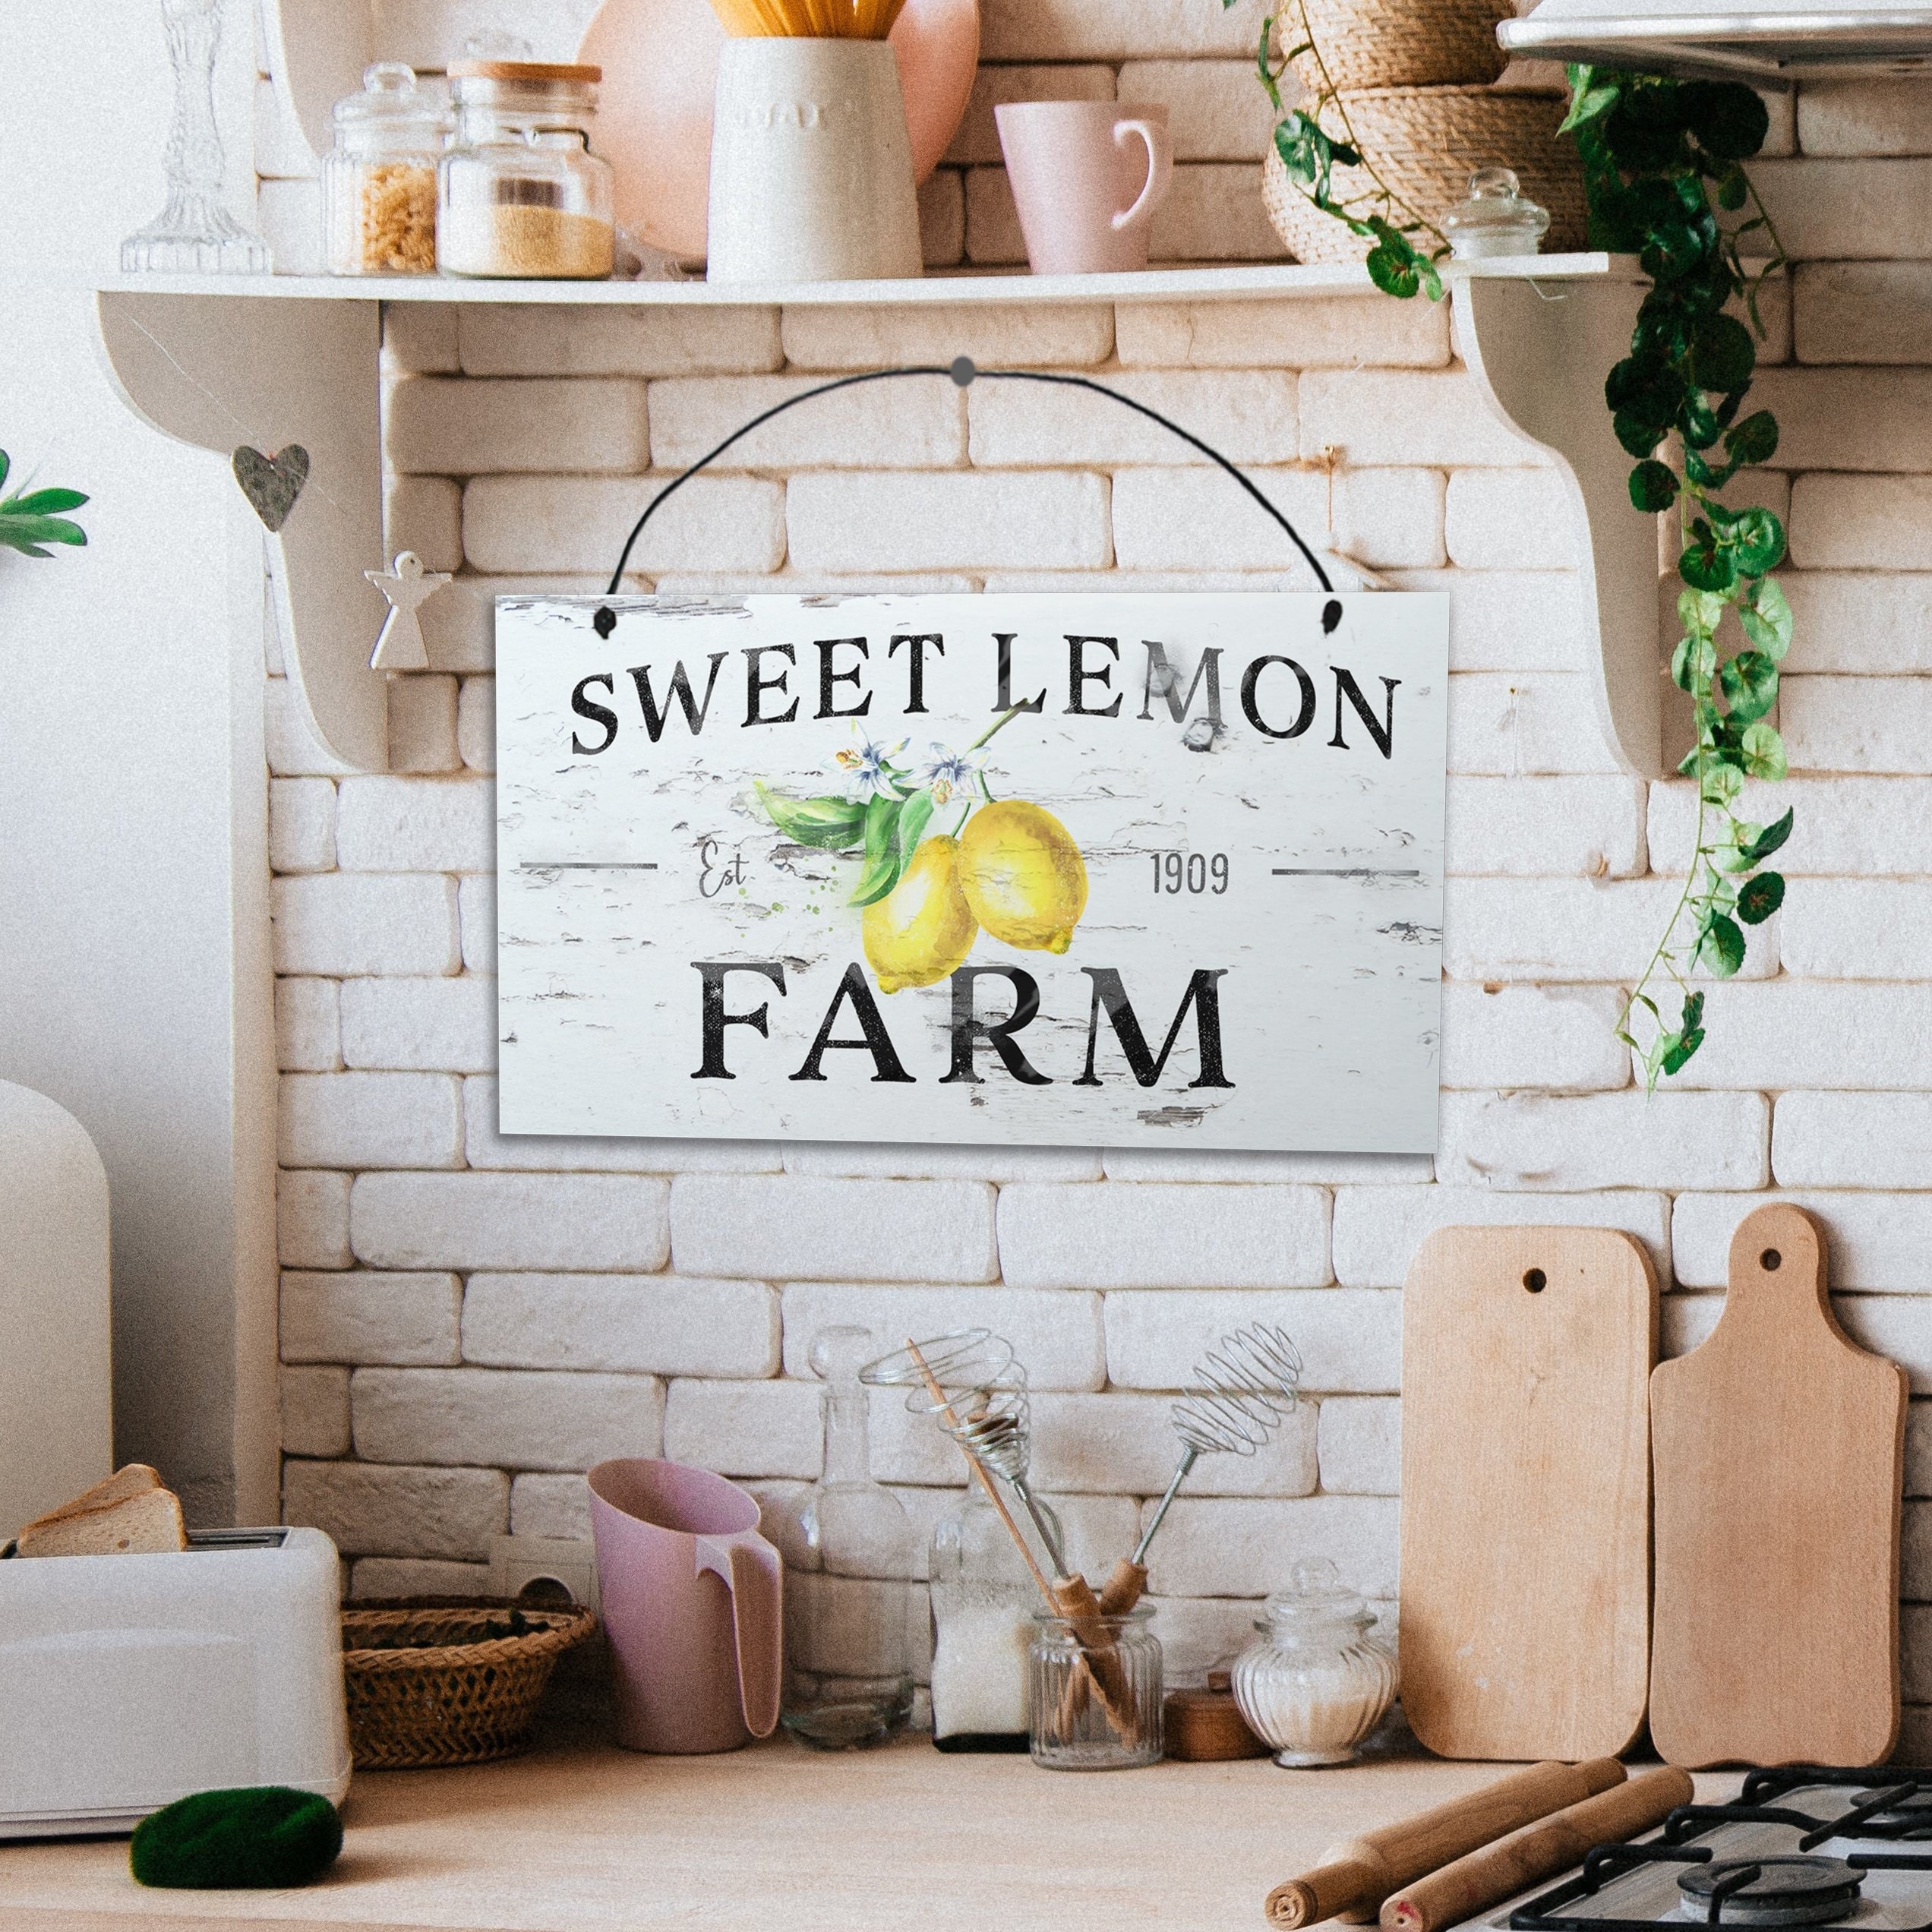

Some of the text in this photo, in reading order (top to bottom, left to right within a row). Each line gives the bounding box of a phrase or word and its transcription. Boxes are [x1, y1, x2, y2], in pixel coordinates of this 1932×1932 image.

[571, 633, 1403, 759] SWEET LEMON
[699, 840, 1229, 898] Est 1909
[690, 961, 1236, 1089] FARM
